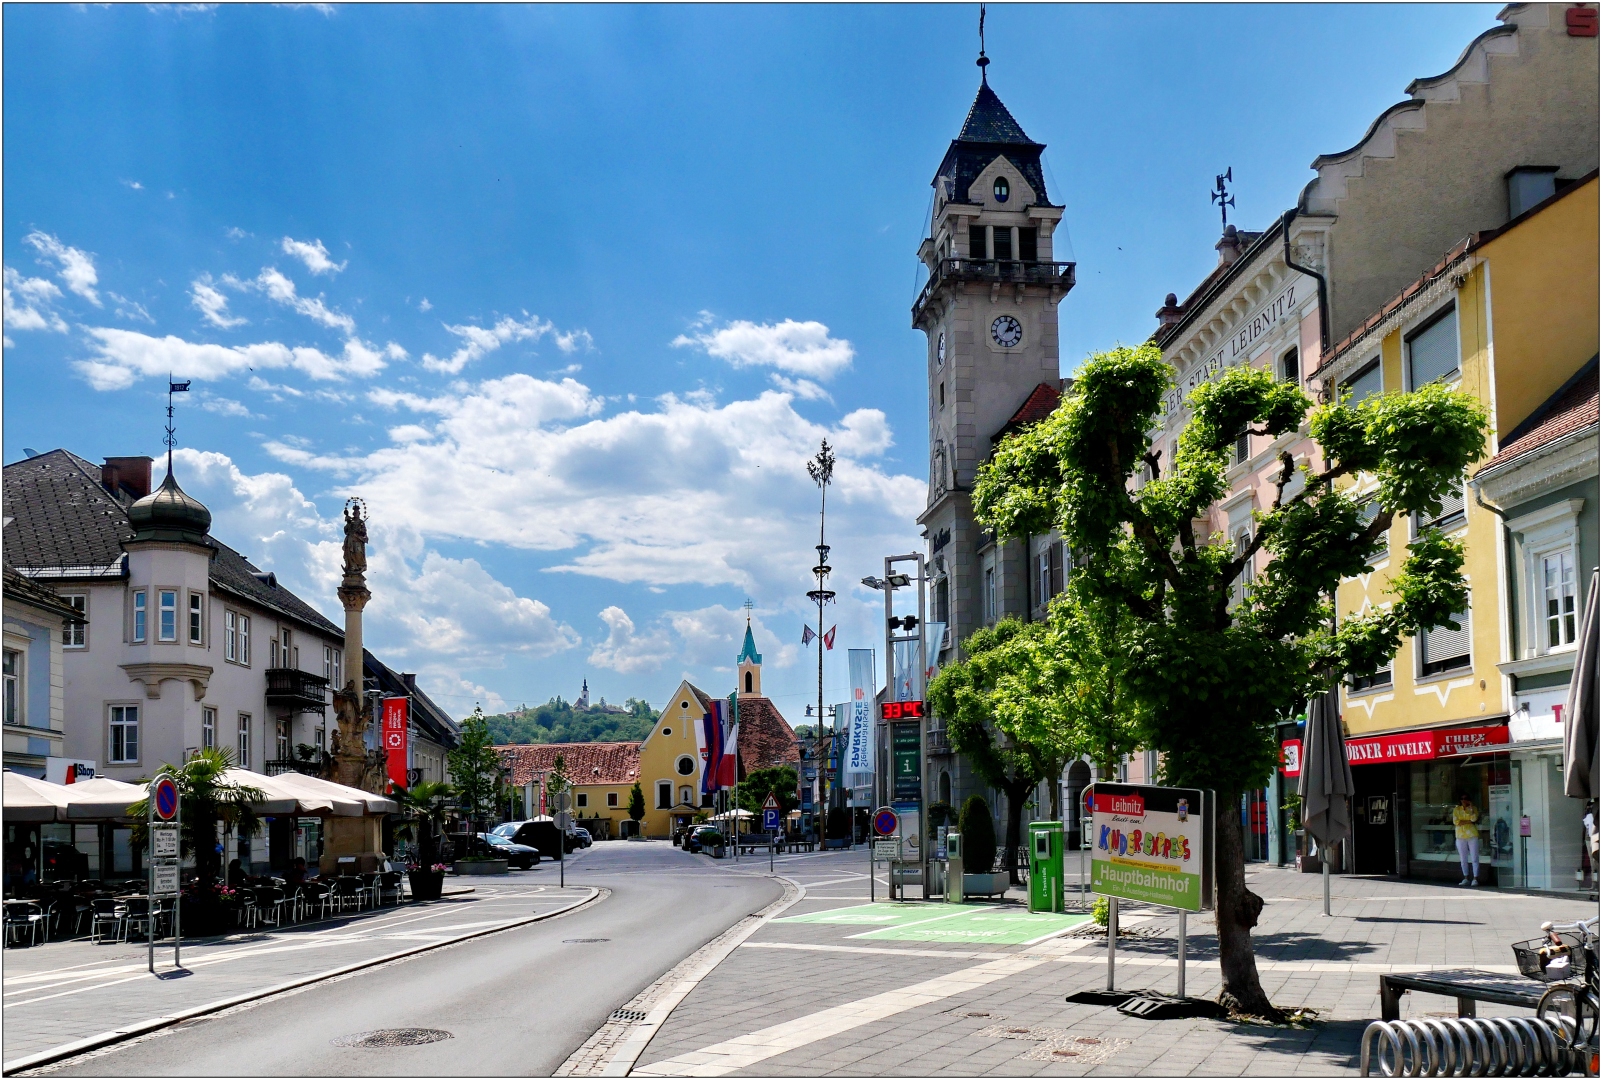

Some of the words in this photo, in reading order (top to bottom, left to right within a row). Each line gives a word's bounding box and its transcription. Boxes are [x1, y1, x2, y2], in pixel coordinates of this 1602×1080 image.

[1232, 286, 1296, 357] LEIBNITZ
[1445, 733, 1485, 743] UHREN
[1386, 741, 1432, 757] JUWELEN
[78, 763, 94, 779] Shop
[1111, 798, 1142, 814] Leibnitz
[767, 811, 776, 824] P
[1100, 864, 1190, 893] Hauptbahnhof
